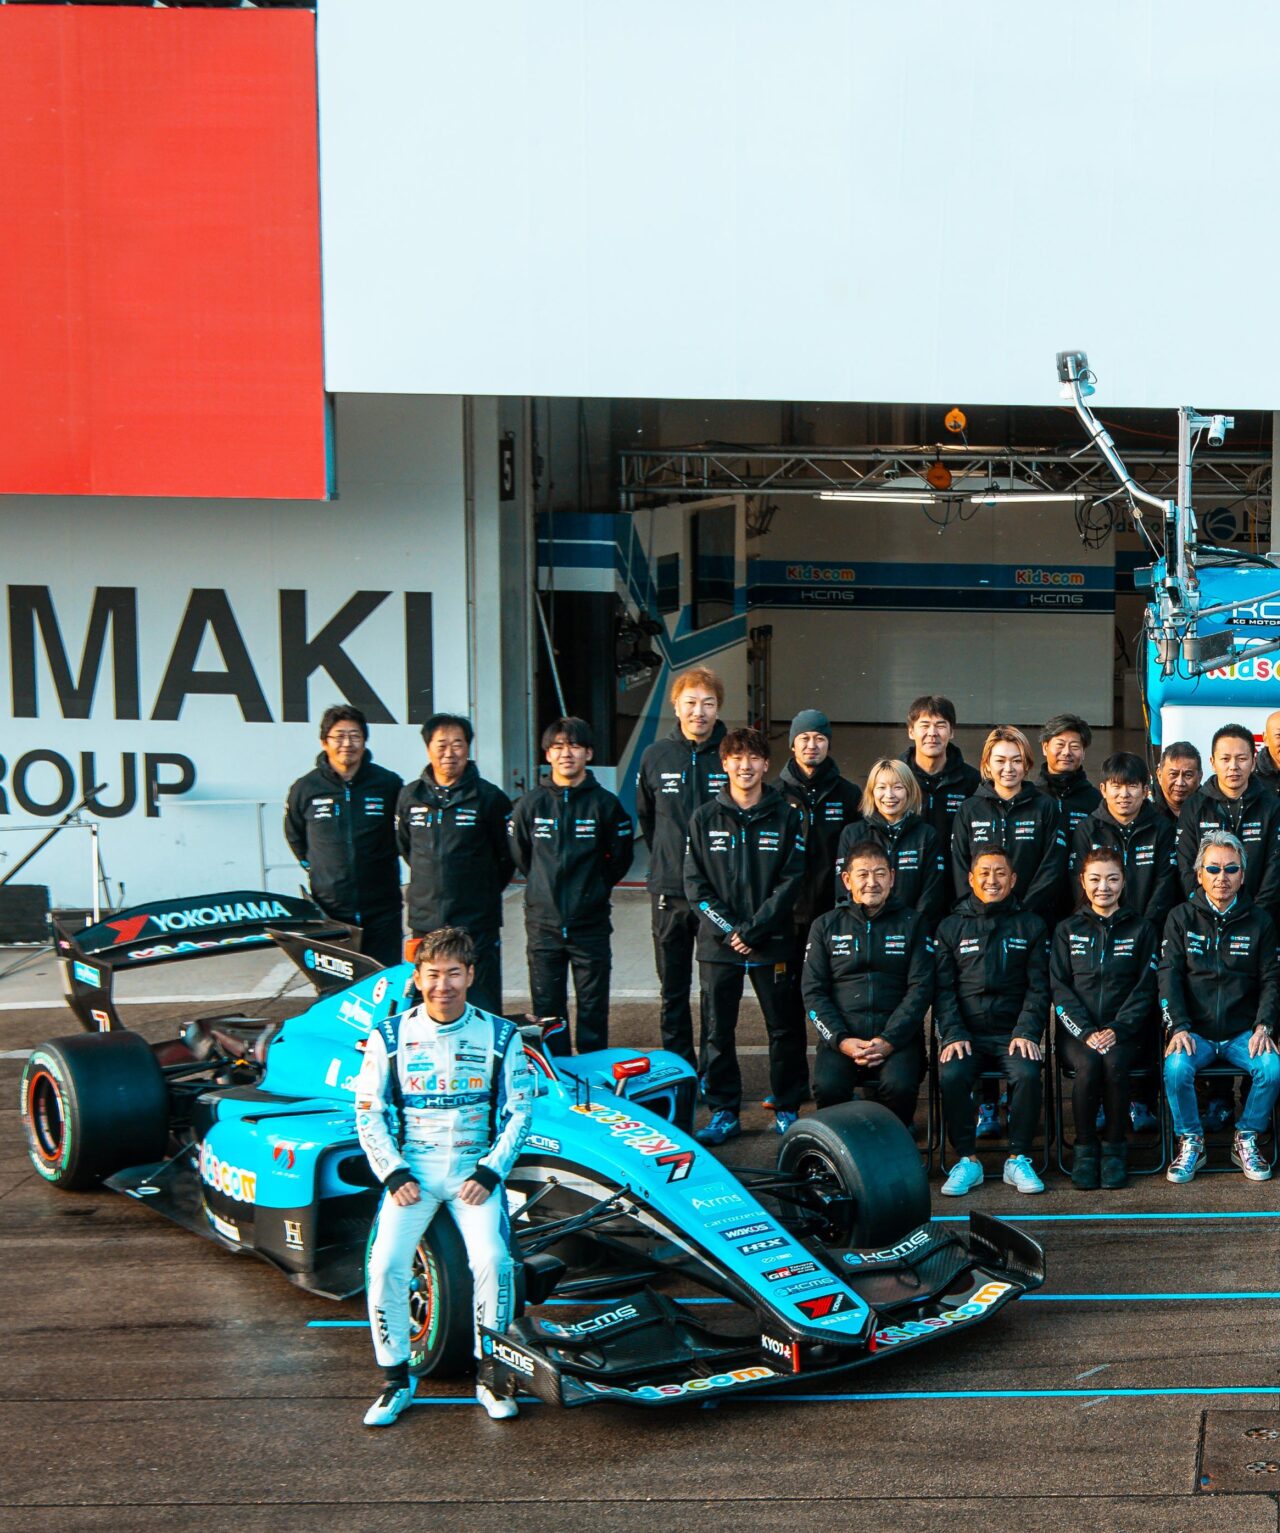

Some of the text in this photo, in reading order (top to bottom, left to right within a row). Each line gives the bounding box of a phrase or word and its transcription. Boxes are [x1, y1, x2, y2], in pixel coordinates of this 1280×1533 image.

[800, 589, 855, 601] KCMG
[1030, 594, 1084, 605] KCMG
[7, 583, 434, 726] MAKI
[149, 901, 292, 931] YOKOHAMA
[410, 1074, 483, 1091] Kids com
[655, 1150, 696, 1185] 7
[692, 1193, 743, 1210] Arms
[742, 1238, 783, 1253] HRX
[860, 1230, 930, 1261] KCMG
[768, 1267, 793, 1280] GR
[787, 1277, 834, 1292] KCMG
[559, 1304, 637, 1335] KCMG
[493, 1340, 534, 1372] KCMG
